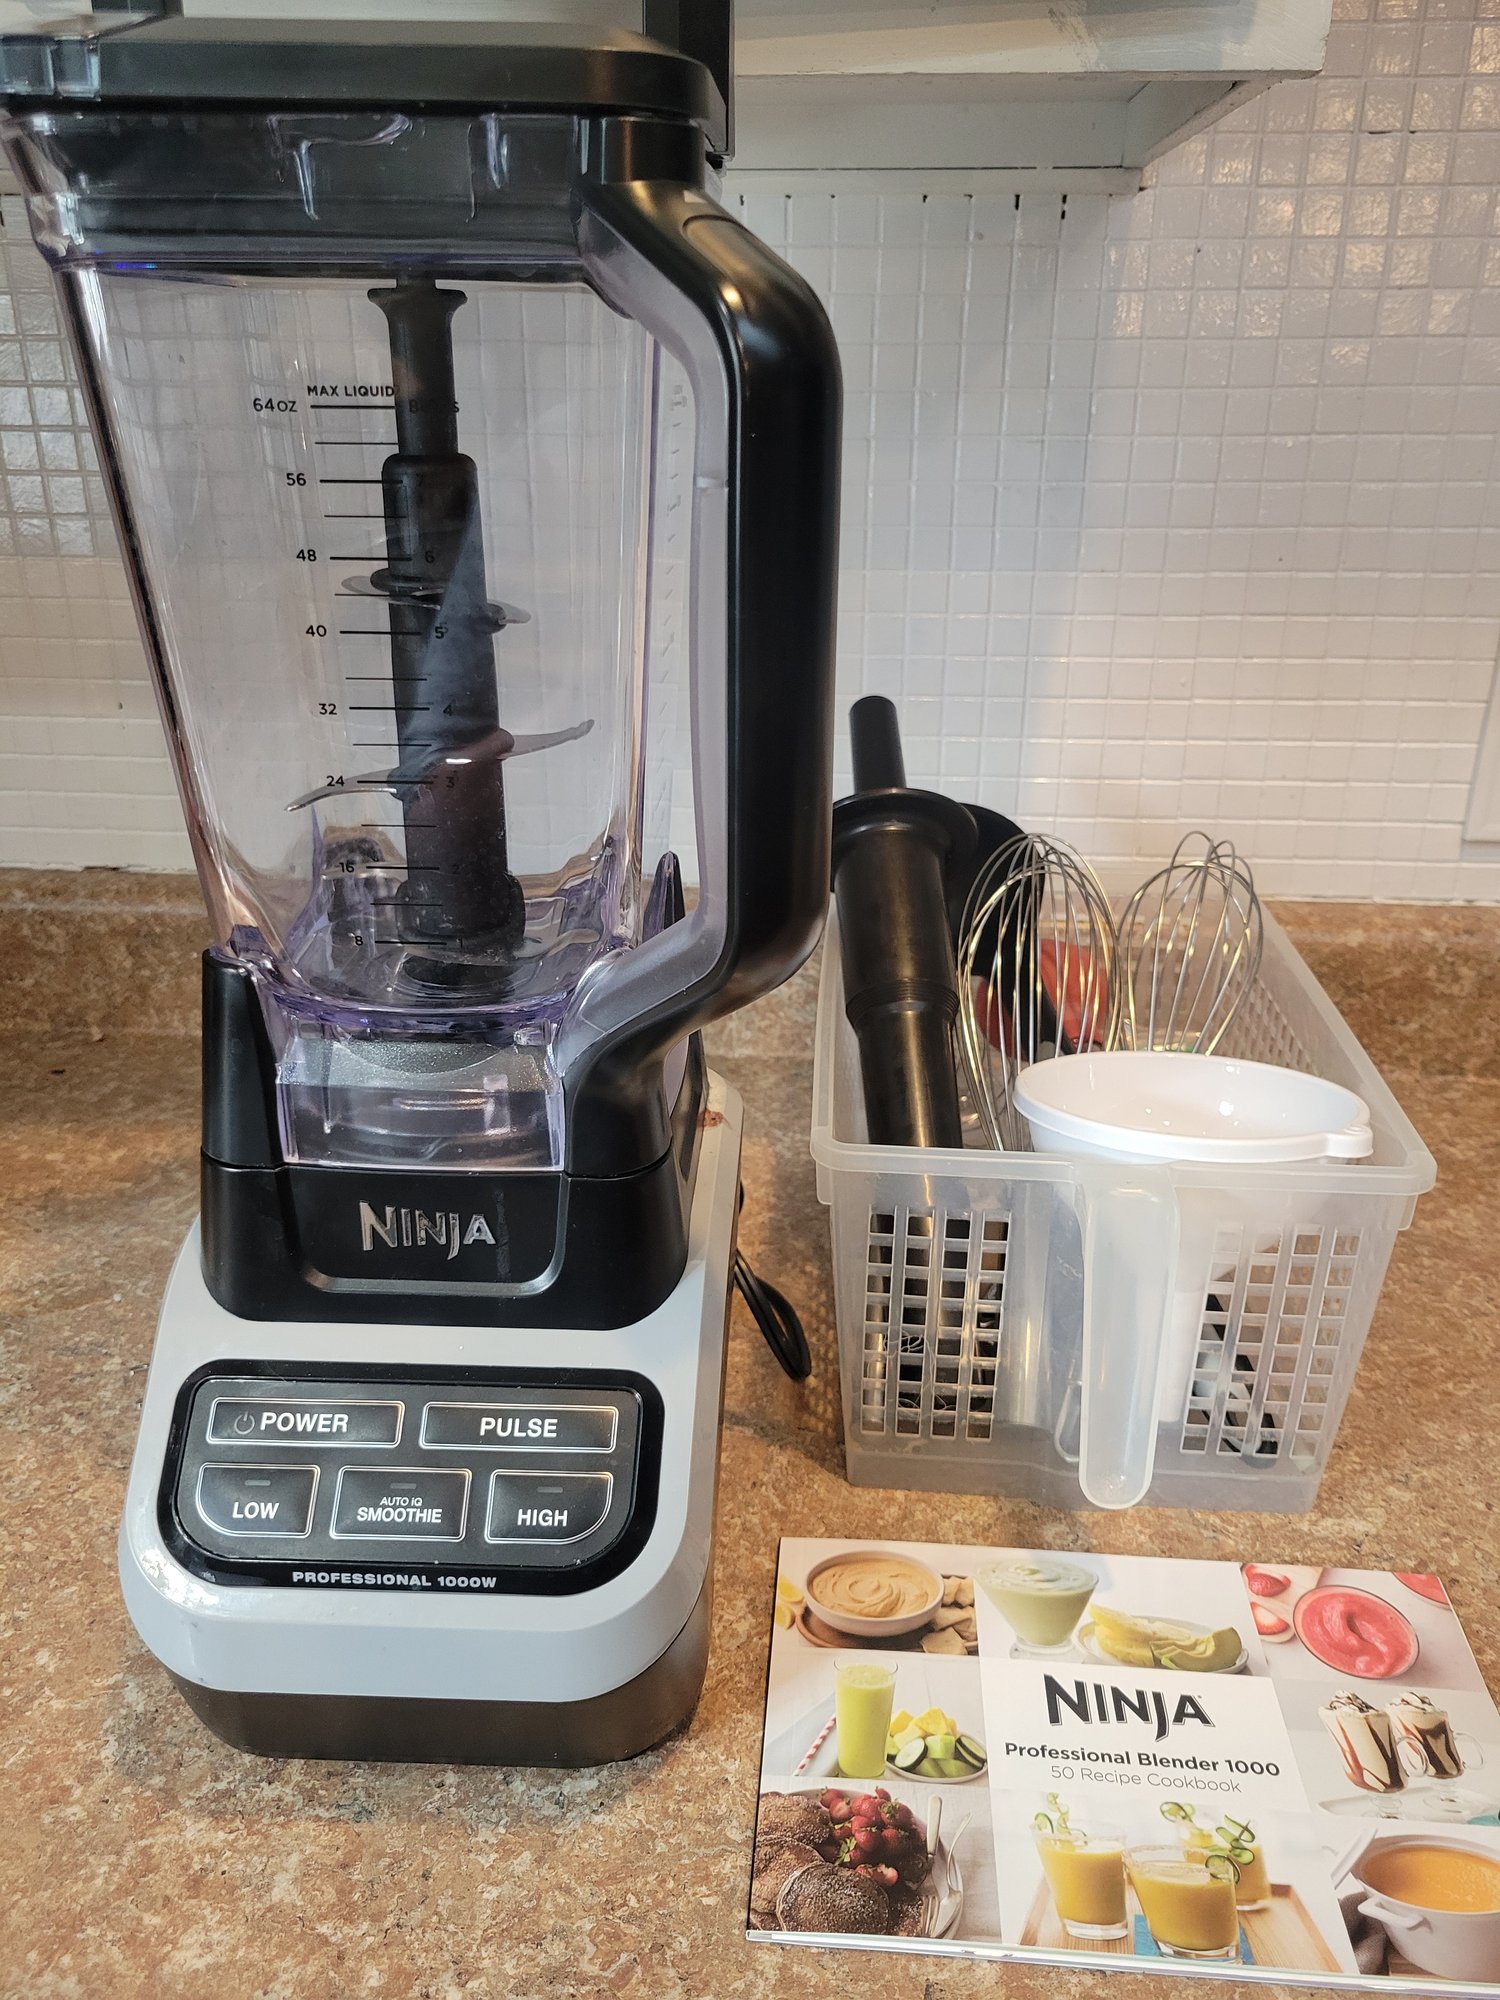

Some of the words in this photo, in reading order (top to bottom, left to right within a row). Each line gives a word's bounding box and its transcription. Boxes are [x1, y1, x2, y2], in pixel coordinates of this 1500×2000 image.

[307, 385, 339, 397] MAX
[344, 385, 395, 398] LIQUID
[253, 397, 298, 413] 64OZ
[286, 473, 307, 486] 56
[296, 550, 317, 562] 48
[425, 551, 435, 563] 6
[305, 626, 327, 638] 40
[434, 627, 445, 639] 5
[319, 703, 337, 715] 32
[443, 704, 453, 716] 4
[326, 776, 345, 787] 24
[446, 776, 455, 788] 3
[338, 862, 355, 873] 16
[354, 936, 364, 947] 8
[360, 1200, 496, 1260] NINJA
[260, 1412, 349, 1433] POWER
[479, 1417, 559, 1438] PULSE
[380, 1497, 409, 1506] AUTO
[411, 1497, 423, 1506] iQ
[232, 1502, 279, 1519] LOW
[357, 1507, 443, 1523] SMOOTHIE
[517, 1508, 568, 1527] HIGH
[292, 1571, 432, 1587] PROFESSIONAL
[437, 1575, 497, 1589] 1000W
[1043, 1673, 1216, 1743] NINJA
[1004, 1742, 1132, 1766] Professional
[1138, 1752, 1220, 1773] Blender
[1224, 1759, 1281, 1777] 1000
[1050, 1765, 1075, 1780] 50
[1081, 1768, 1142, 1788] Recipe
[1147, 1773, 1243, 1794] Cookbook
